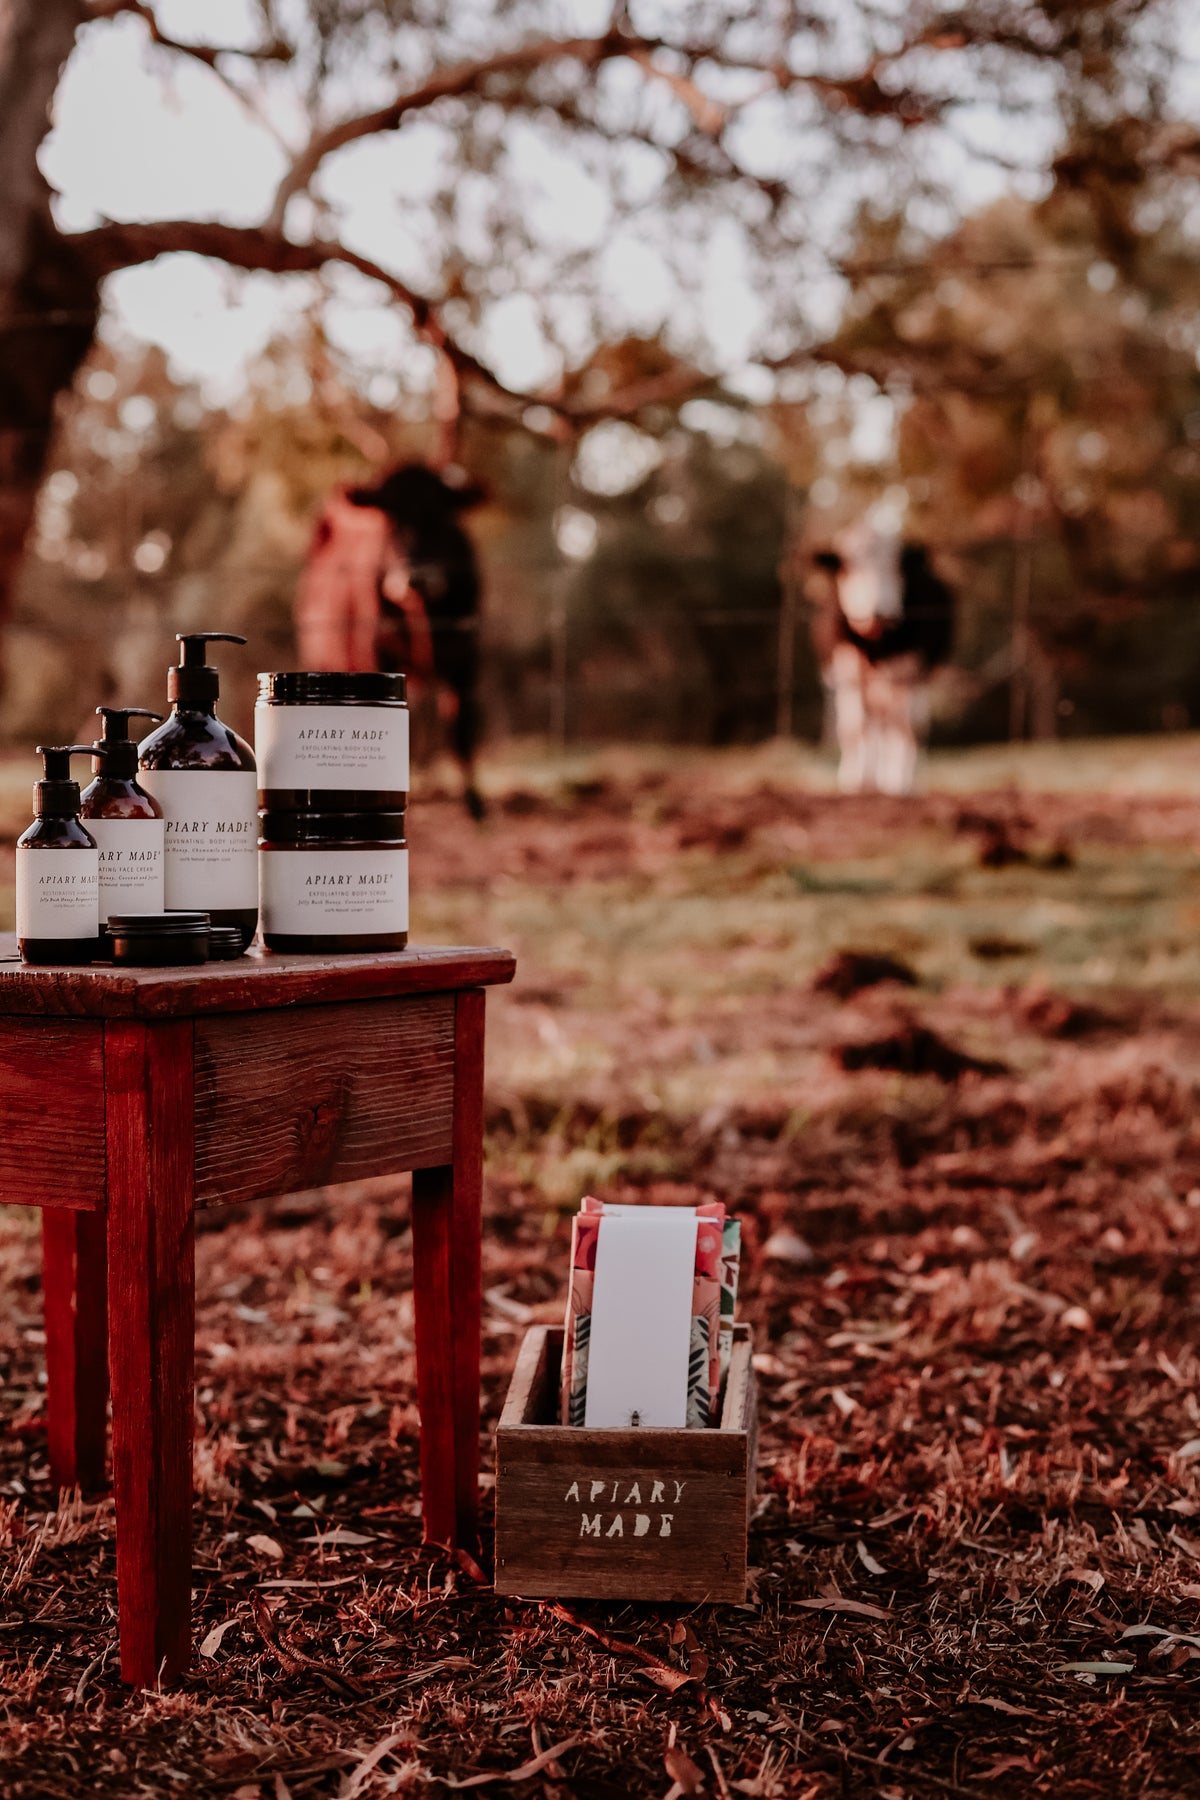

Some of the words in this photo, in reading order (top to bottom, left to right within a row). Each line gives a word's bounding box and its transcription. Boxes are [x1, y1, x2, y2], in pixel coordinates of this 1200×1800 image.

[298, 729, 345, 739] APIARY
[166, 821, 209, 832] PIARY
[98, 851, 123, 861] ARY
[39, 875, 76, 884] APIARY
[305, 874, 352, 885] APIARY
[564, 1480, 687, 1504] APIARY
[579, 1513, 674, 1537] MADE
